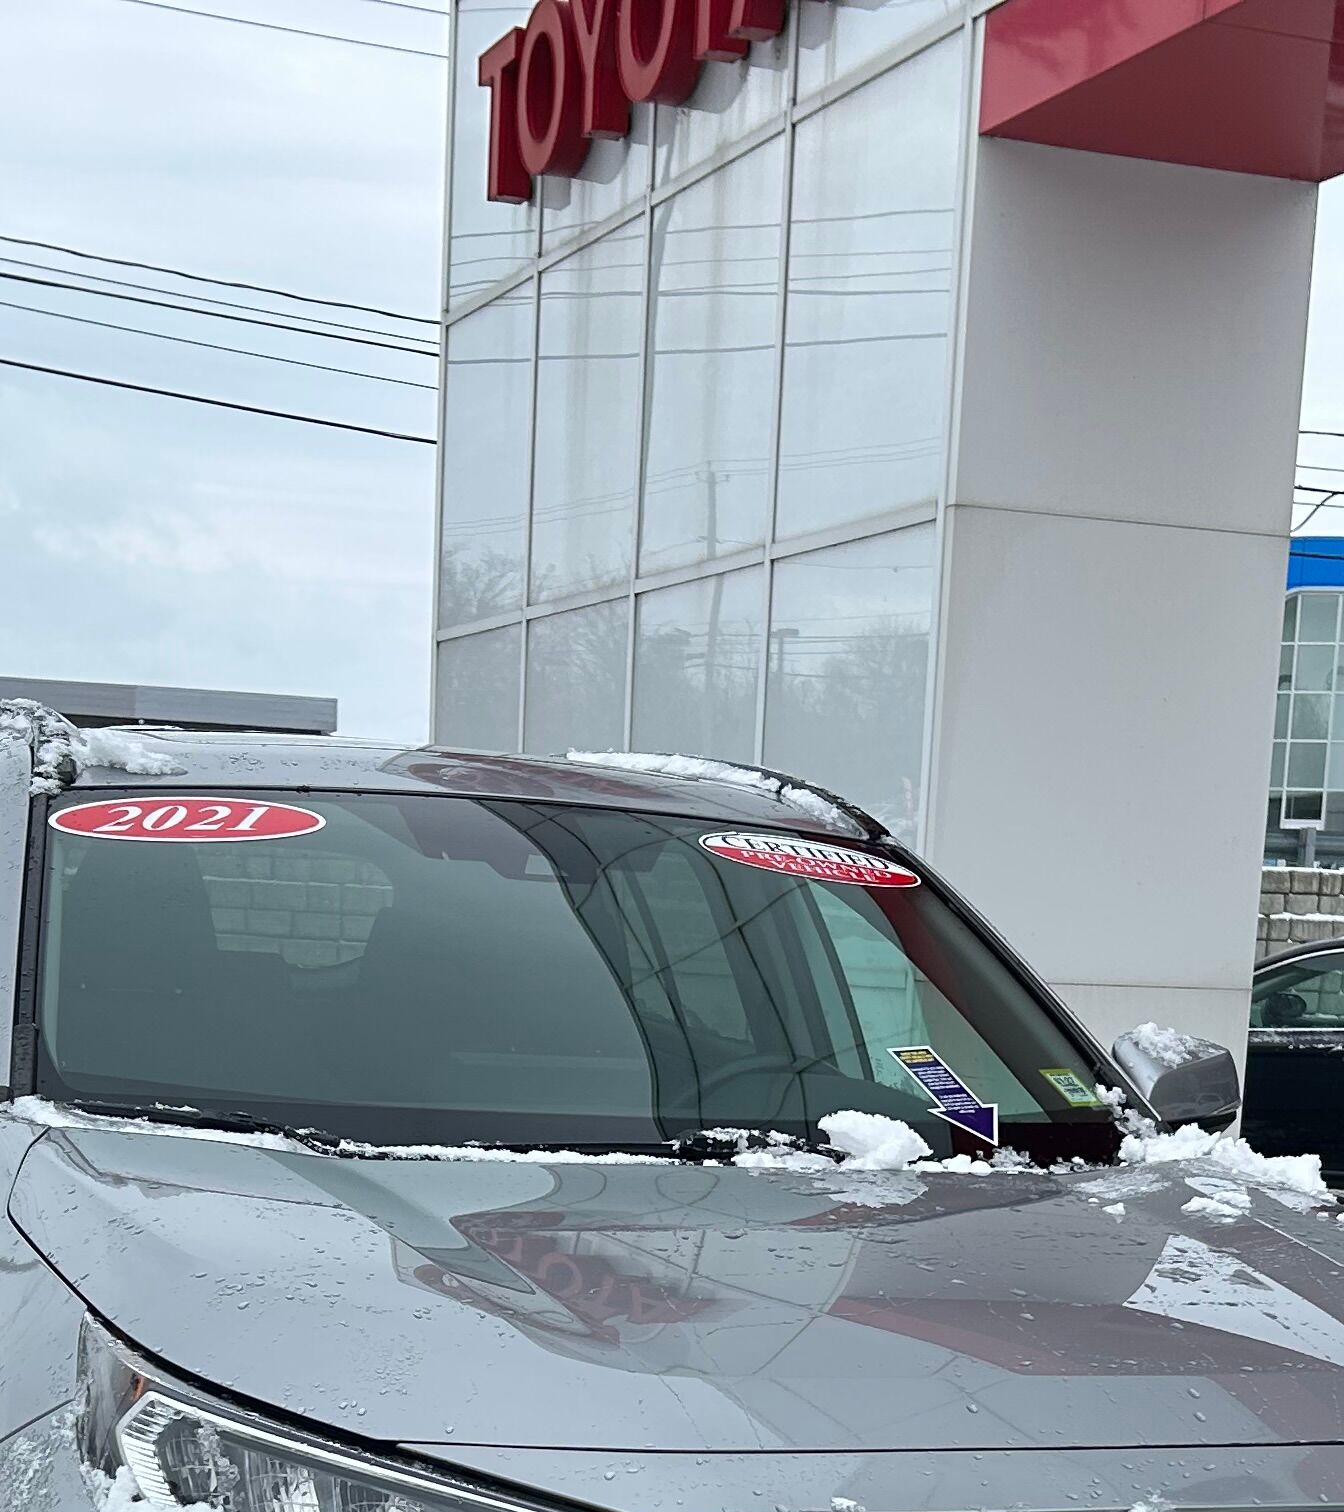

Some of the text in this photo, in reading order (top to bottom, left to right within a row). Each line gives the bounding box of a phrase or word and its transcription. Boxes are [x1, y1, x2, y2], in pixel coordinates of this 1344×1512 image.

[478, 0, 787, 204] TOYO
[93, 805, 270, 832] 2021
[722, 835, 891, 871] CERTIFIED
[769, 859, 880, 884] VEHICLE
